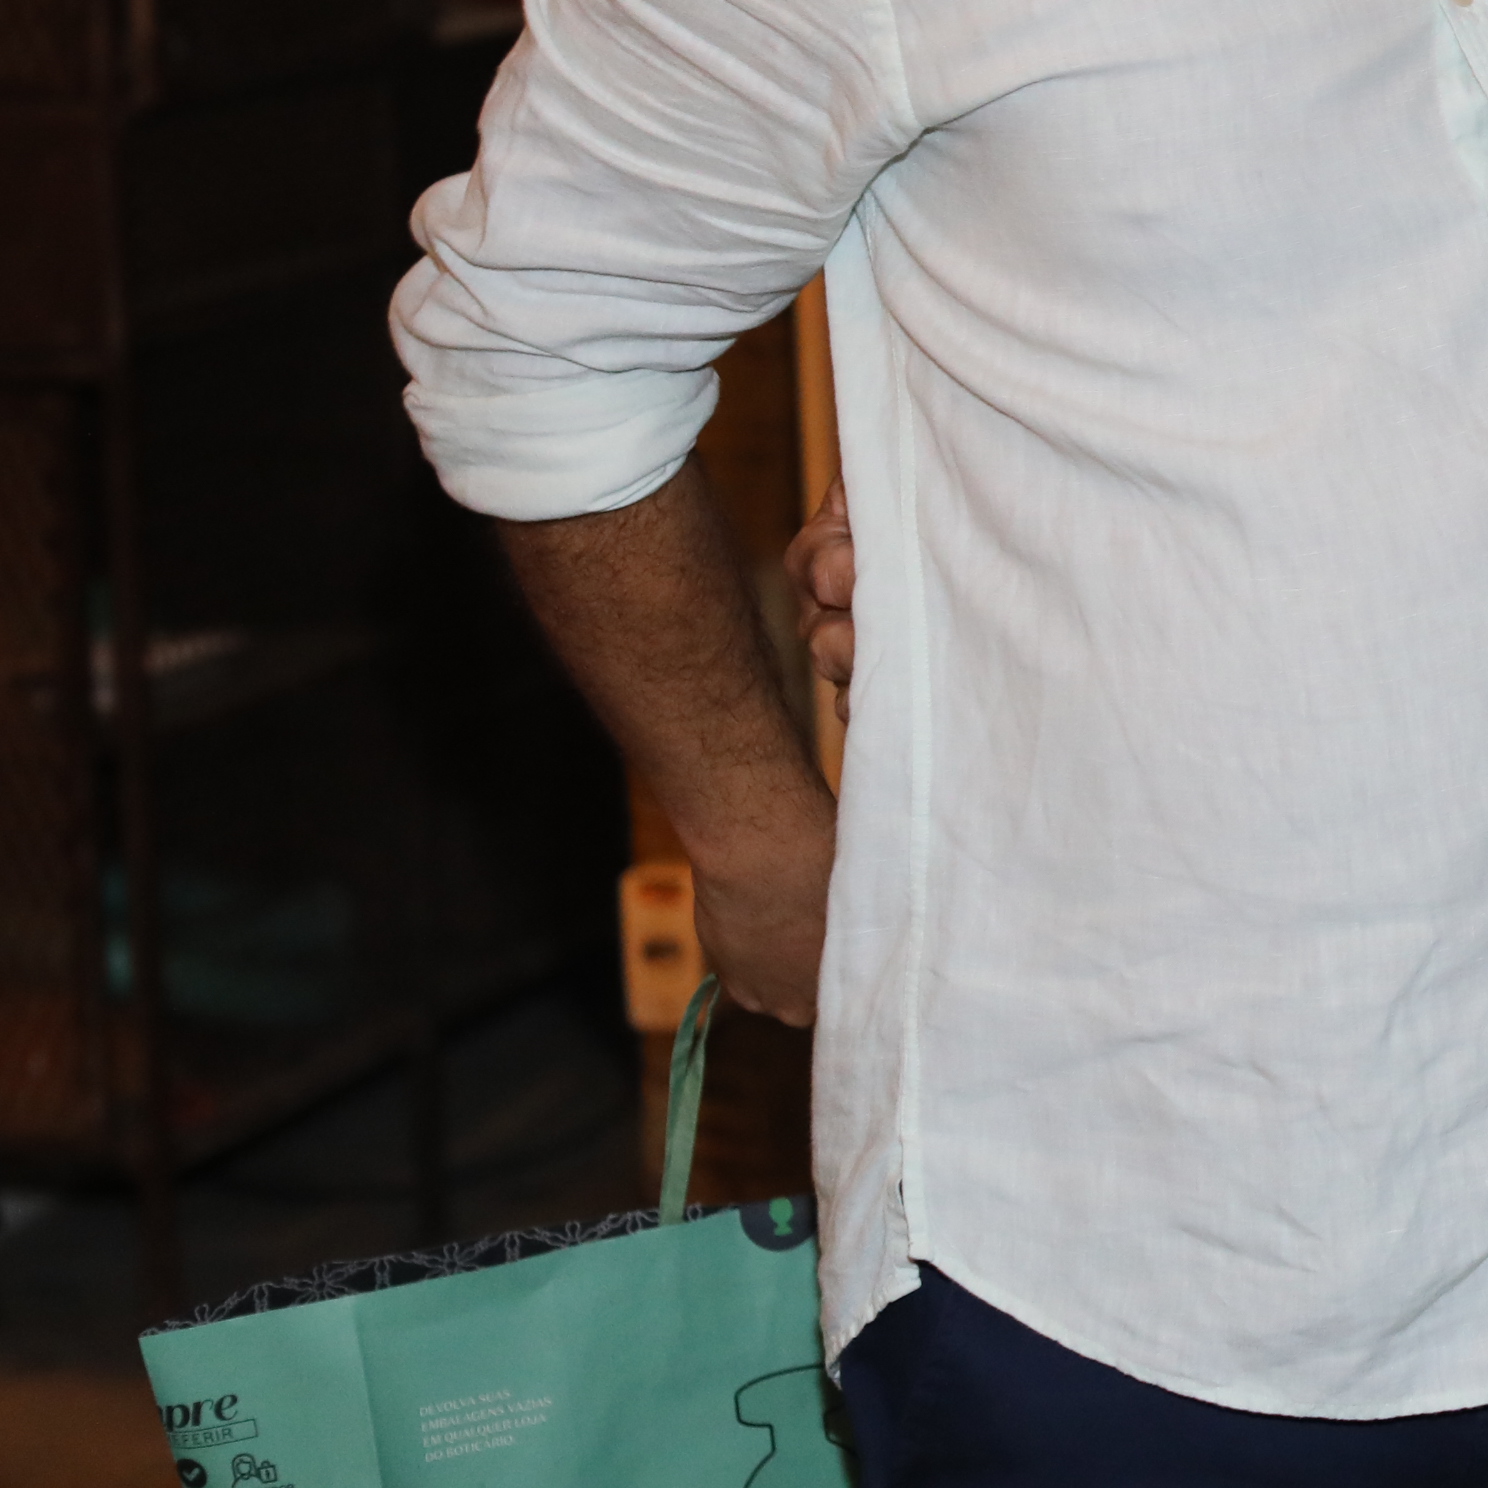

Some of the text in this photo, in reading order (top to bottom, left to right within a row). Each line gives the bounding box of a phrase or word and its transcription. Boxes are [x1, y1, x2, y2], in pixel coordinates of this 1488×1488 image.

[420, 1389, 511, 1417] DEVOLVA SUAS
[421, 1396, 552, 1432] EMBALAGENS VAZIAS
[169, 1427, 234, 1447] EFERIR
[423, 1413, 547, 1448] EM QUALQUER LOJA
[425, 1450, 443, 1462] DO
